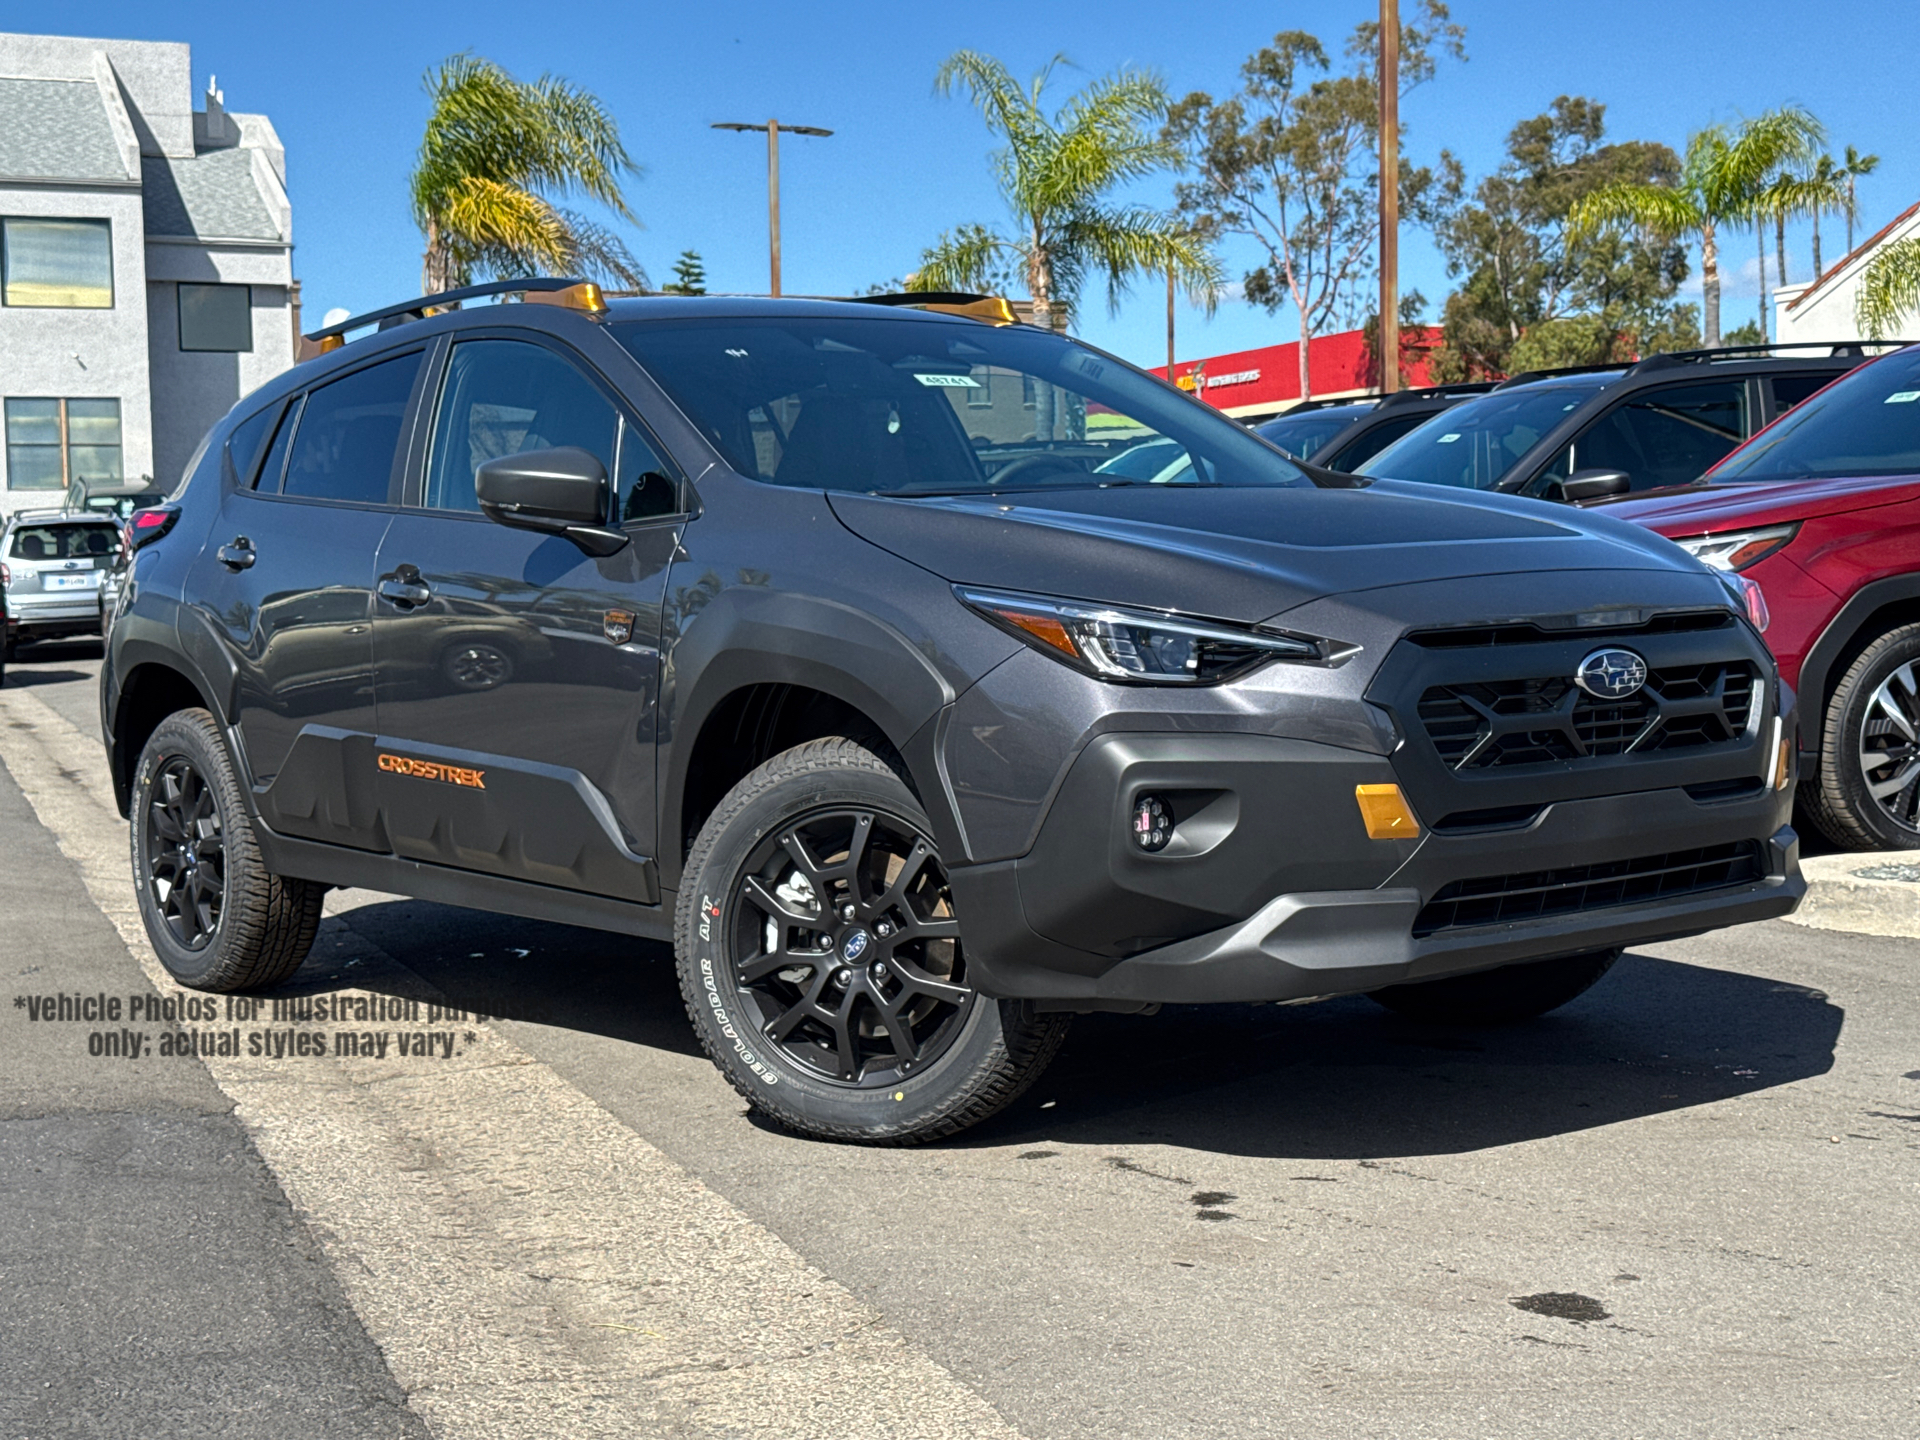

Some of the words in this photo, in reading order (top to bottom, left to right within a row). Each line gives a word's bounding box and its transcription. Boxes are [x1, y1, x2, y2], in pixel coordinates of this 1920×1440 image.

[377, 753, 486, 789] CROSSTREK
[699, 895, 713, 942] A/T
[700, 958, 779, 1085] GEOLANDAR
